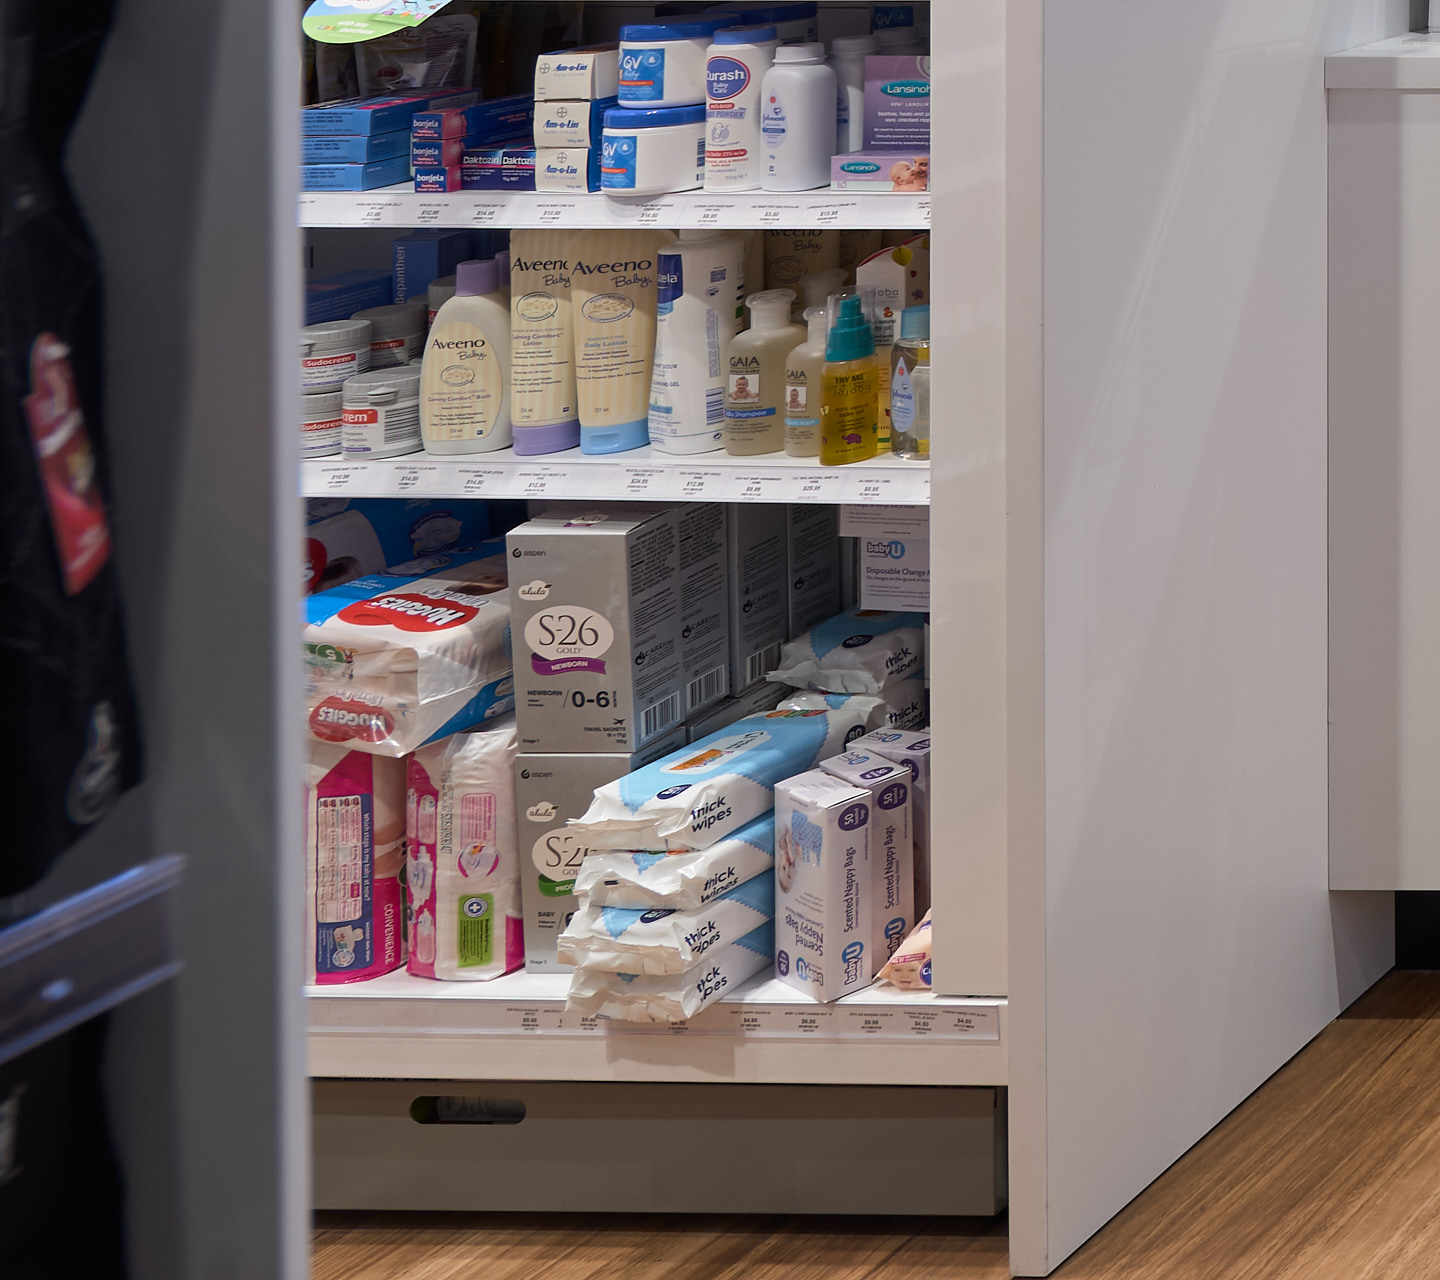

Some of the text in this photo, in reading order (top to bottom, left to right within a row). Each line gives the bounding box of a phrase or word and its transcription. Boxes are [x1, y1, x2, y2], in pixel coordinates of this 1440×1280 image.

[572, 259, 652, 276] Aveeno
[728, 355, 760, 368] GAIA
[539, 614, 599, 646] S-26
[692, 806, 732, 833] wipes
